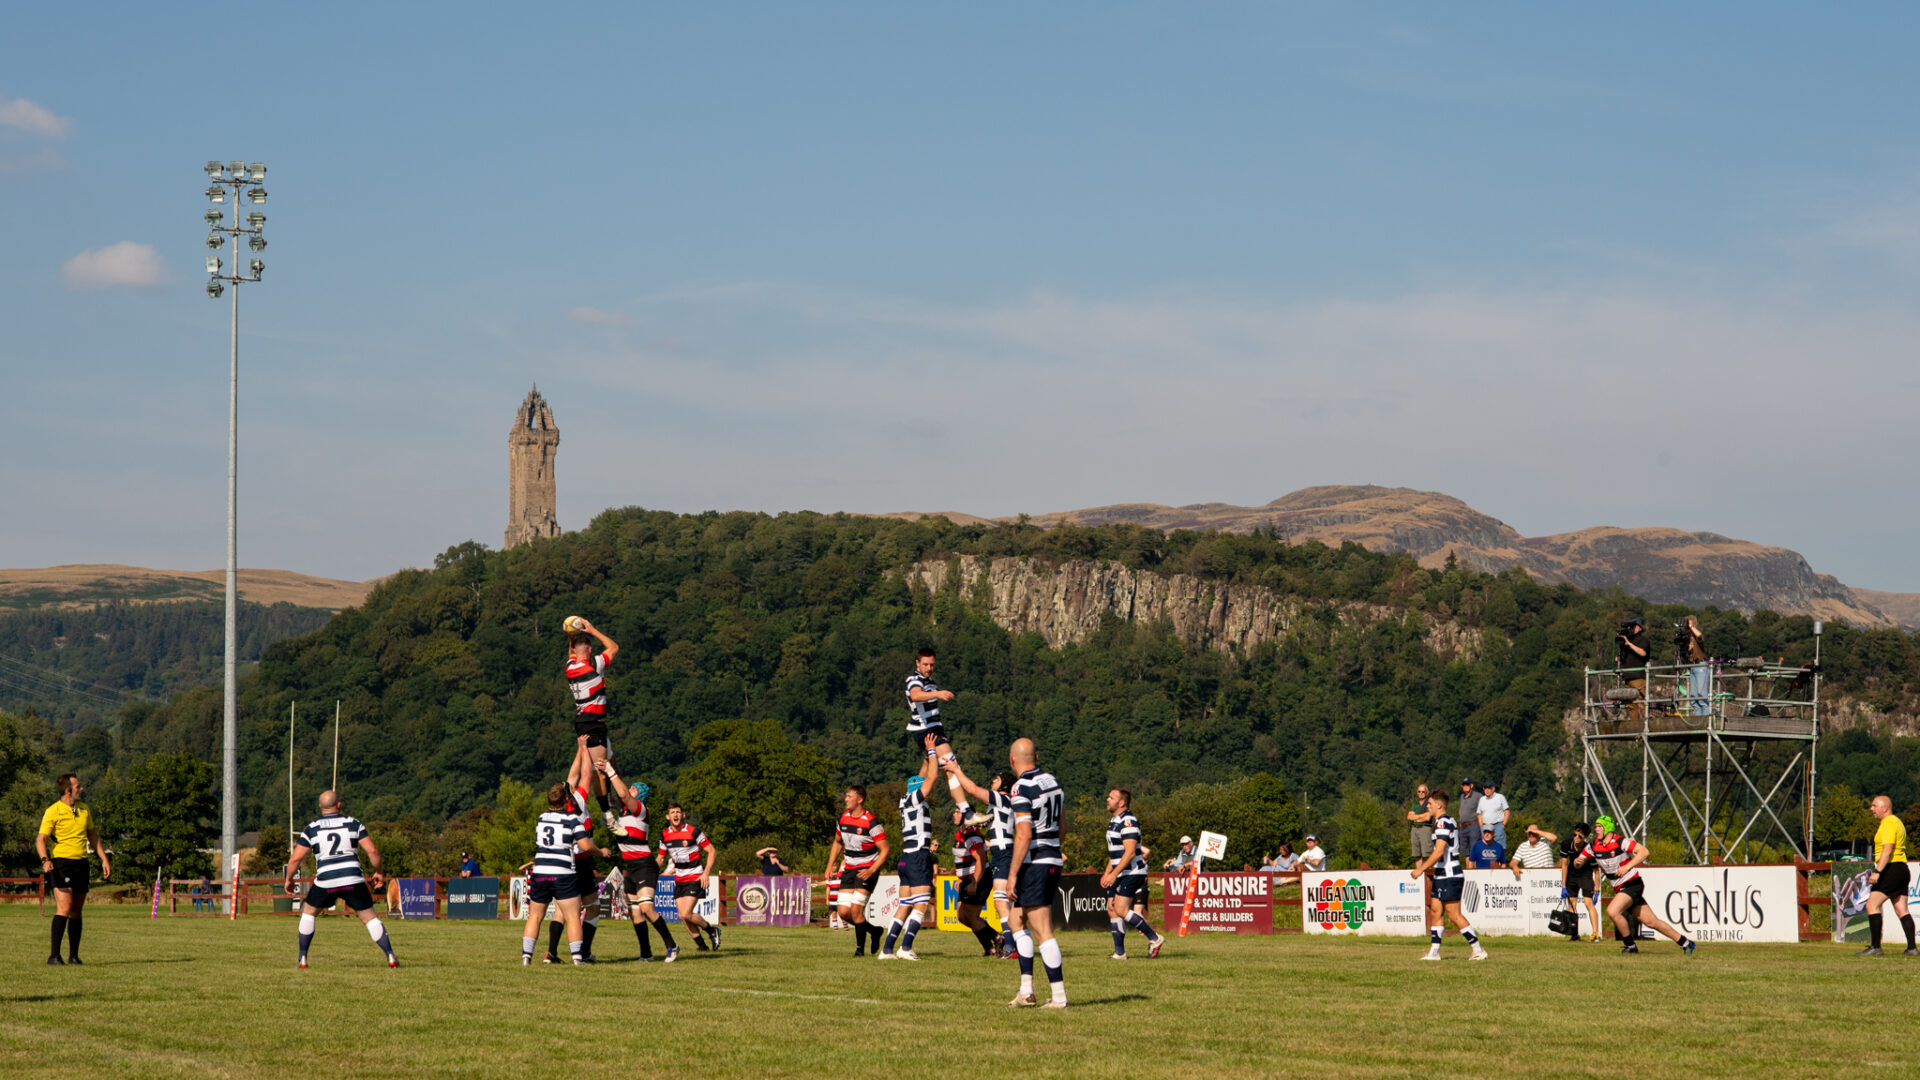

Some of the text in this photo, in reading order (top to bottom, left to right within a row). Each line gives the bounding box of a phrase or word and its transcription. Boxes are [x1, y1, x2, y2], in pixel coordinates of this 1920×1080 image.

[1045, 794, 1062, 828] 14
[543, 826, 555, 846] 3
[327, 832, 343, 856] 2
[1198, 876, 1268, 896] DUNSIRE
[1307, 885, 1375, 902] KILGANNON
[1484, 883, 1523, 896] Richardson
[449, 894, 466, 903] GRAHAM
[1194, 898, 1242, 908] & SONS LTD
[1484, 896, 1518, 911] & Starling
[1212, 912, 1219, 922] &
[1220, 912, 1254, 922] BUILDERS
[1308, 907, 1350, 923] Motors
[1354, 906, 1374, 922] Ltd
[1199, 924, 1236, 932] www.dunsire.com
[1696, 929, 1744, 941] BREWING
